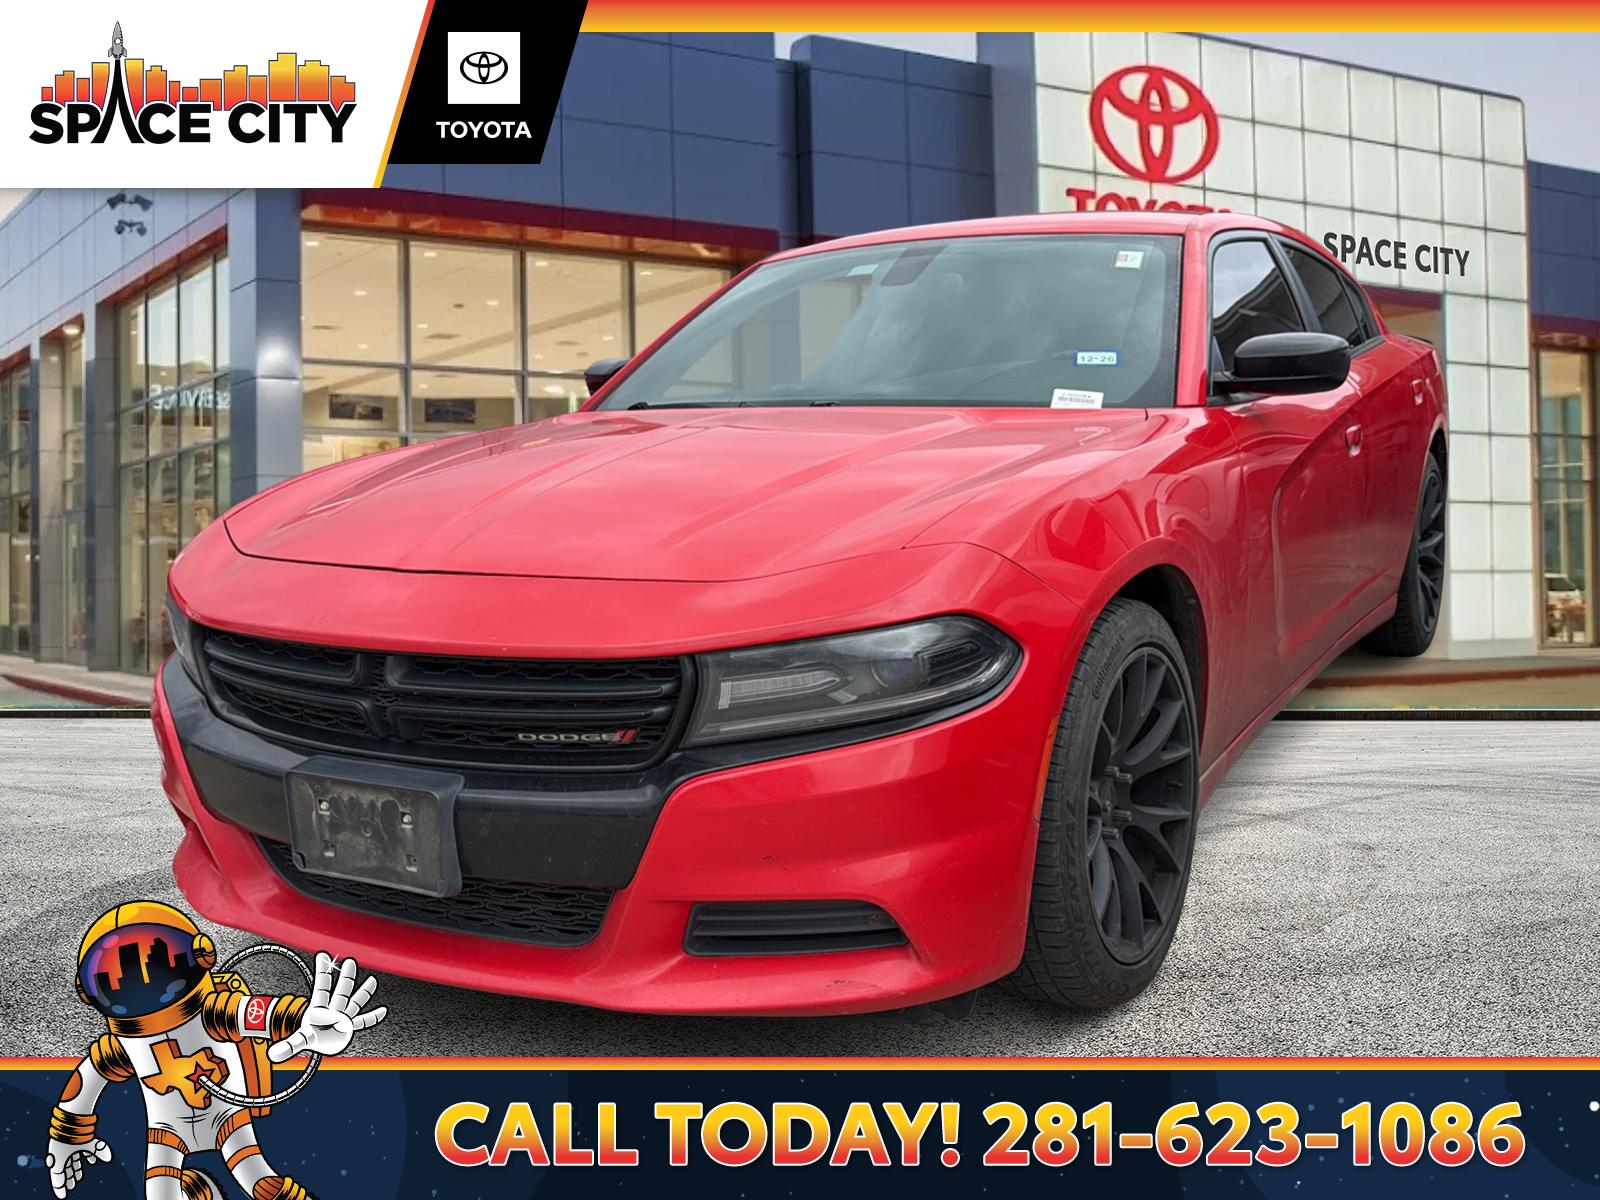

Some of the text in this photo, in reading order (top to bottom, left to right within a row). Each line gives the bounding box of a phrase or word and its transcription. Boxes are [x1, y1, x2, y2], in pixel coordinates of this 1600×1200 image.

[1066, 188, 1232, 213] TOY
[1324, 232, 1470, 276] SPACE CITY
[518, 733, 622, 742] DODGE
